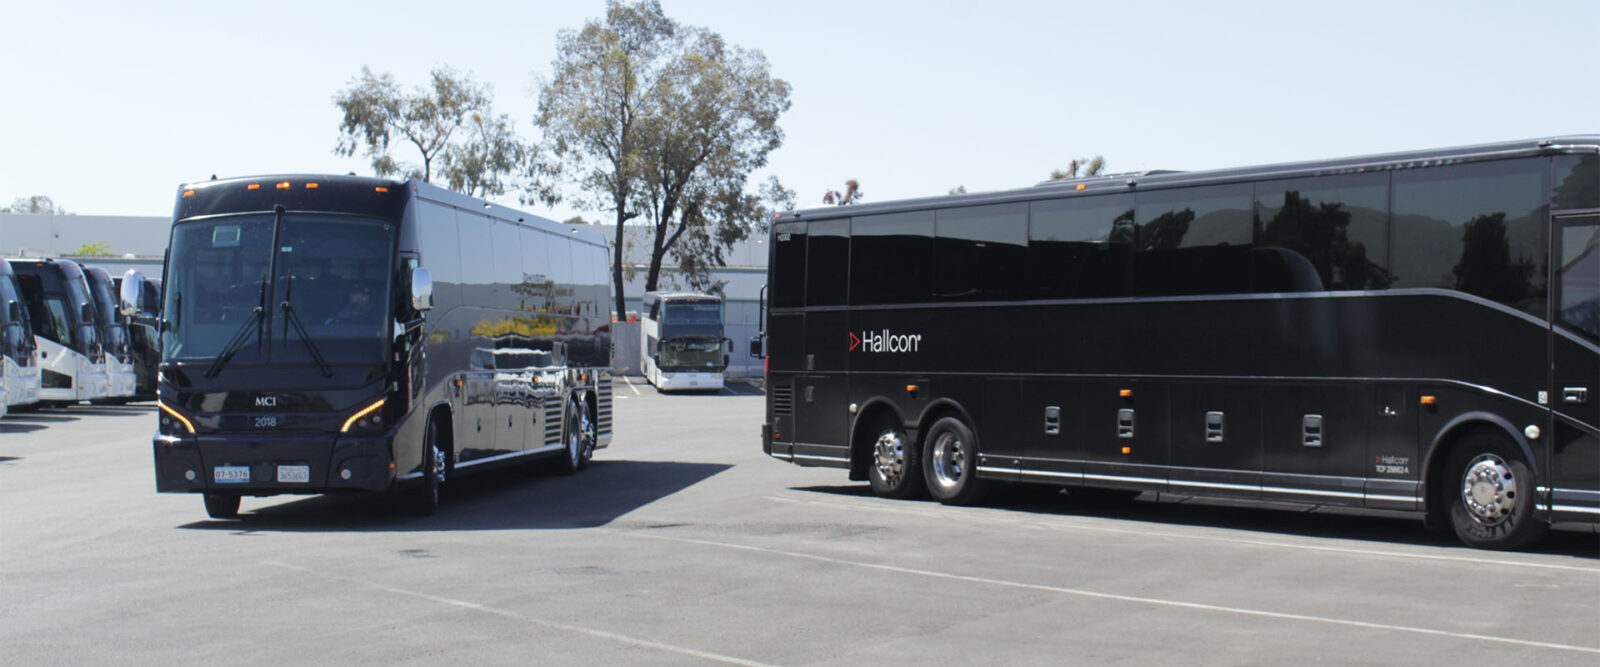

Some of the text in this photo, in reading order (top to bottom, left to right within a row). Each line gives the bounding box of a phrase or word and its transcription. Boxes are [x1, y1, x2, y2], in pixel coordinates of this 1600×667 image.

[255, 396, 276, 406] MCI
[255, 417, 277, 427] 2018
[1375, 465, 1386, 473] TCP
[215, 470, 249, 479] 07-5376
